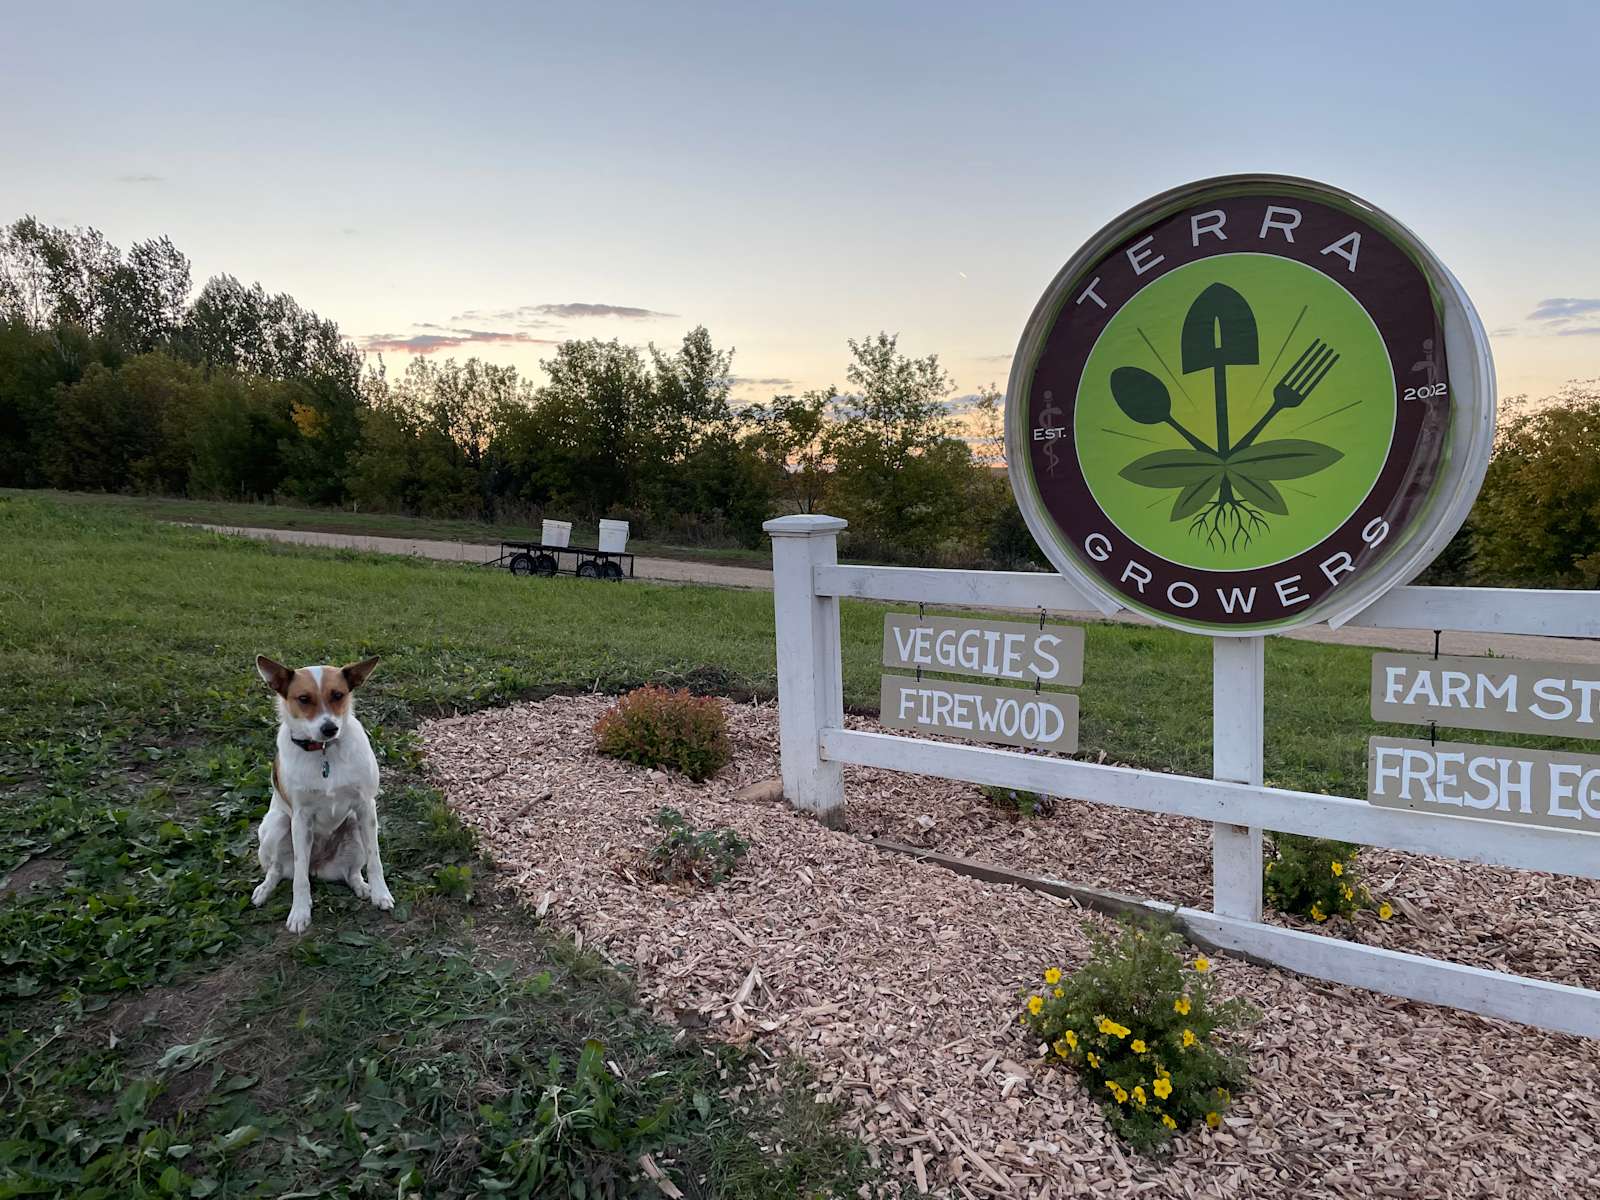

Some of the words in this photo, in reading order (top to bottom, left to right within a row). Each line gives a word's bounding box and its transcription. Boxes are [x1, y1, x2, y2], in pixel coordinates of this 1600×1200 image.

[1076, 205, 1362, 310] TERRA
[1033, 427, 1067, 441] EST.
[1084, 516, 1390, 614] GROWERS
[893, 627, 1063, 679] VEGGIES
[898, 688, 1065, 743] FIREWOOD
[1384, 667, 1518, 713] FARM
[1528, 678, 1600, 723] ST
[1372, 747, 1534, 814] FRESH
